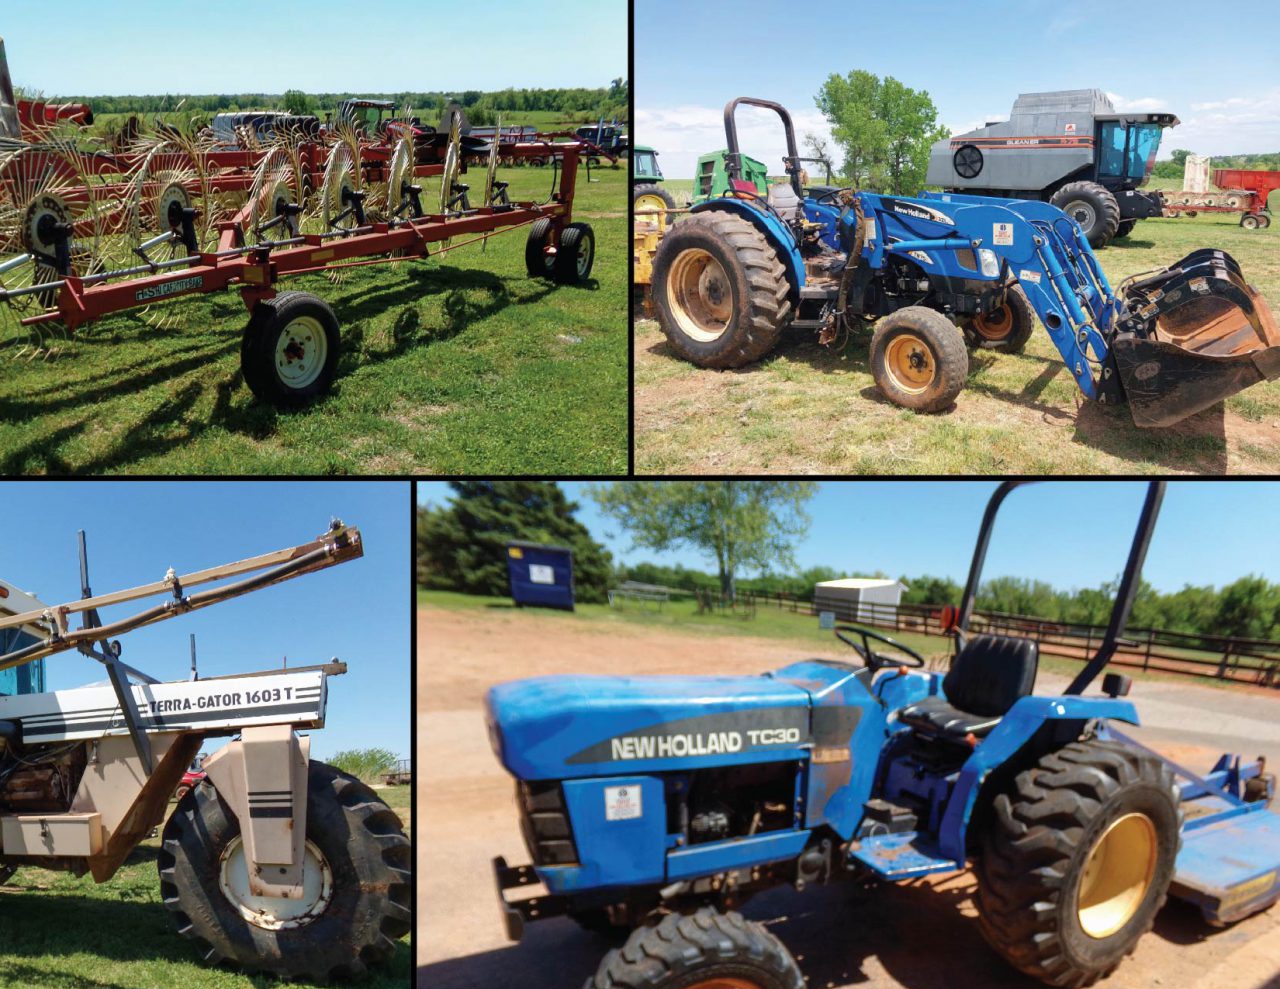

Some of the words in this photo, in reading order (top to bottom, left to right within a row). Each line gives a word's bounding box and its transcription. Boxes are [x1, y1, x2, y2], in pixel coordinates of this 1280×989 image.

[894, 205, 908, 215] New
[908, 208, 931, 220] Holland
[149, 692, 241, 713] TERRA-GATOR
[246, 688, 281, 705] 1603
[283, 687, 293, 700] T
[611, 736, 656, 760] NEW
[658, 731, 742, 757] HOLLAND
[747, 728, 800, 745] TC30
